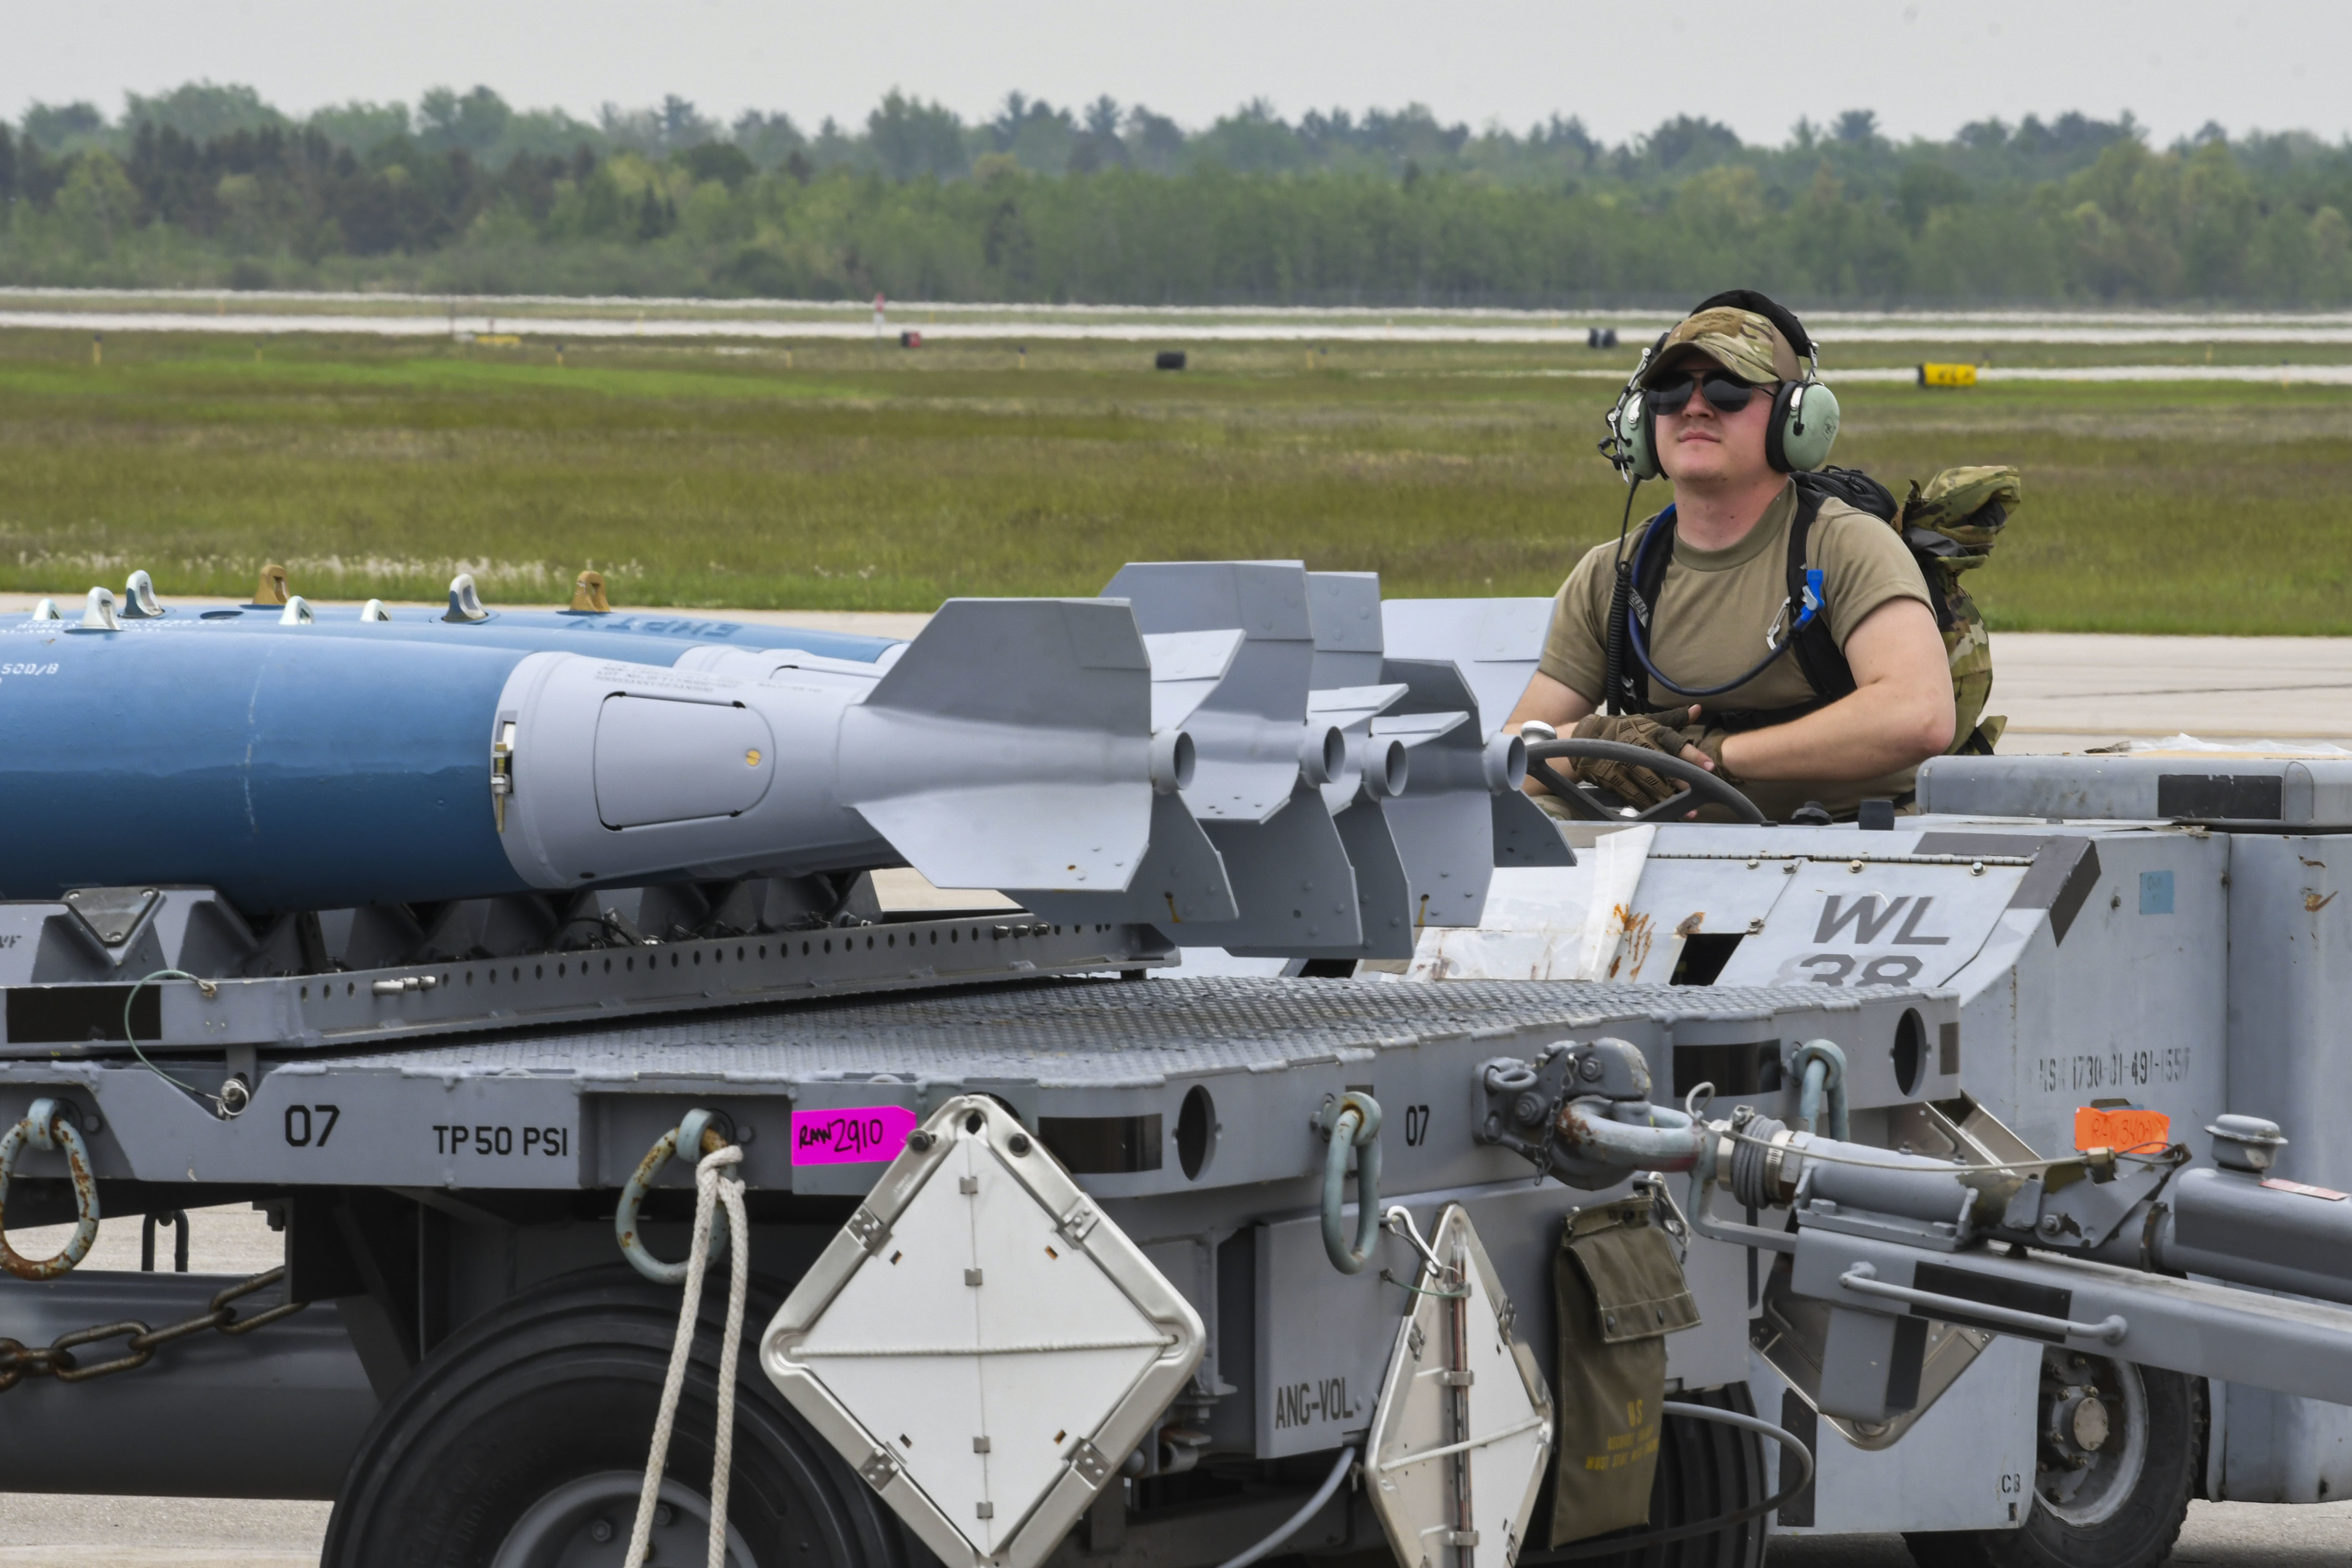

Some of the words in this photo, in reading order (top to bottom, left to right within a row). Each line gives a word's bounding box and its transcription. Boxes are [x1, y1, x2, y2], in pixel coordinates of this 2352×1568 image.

[1813, 895, 1950, 945] WL
[285, 1105, 340, 1147] 07
[433, 1125, 469, 1154] TP
[475, 1126, 512, 1155] 50
[523, 1127, 567, 1156] PSI
[1406, 1105, 1430, 1146] 07
[1275, 1377, 1353, 1429] ANG-VOL
[1628, 1399, 1643, 1427] US
